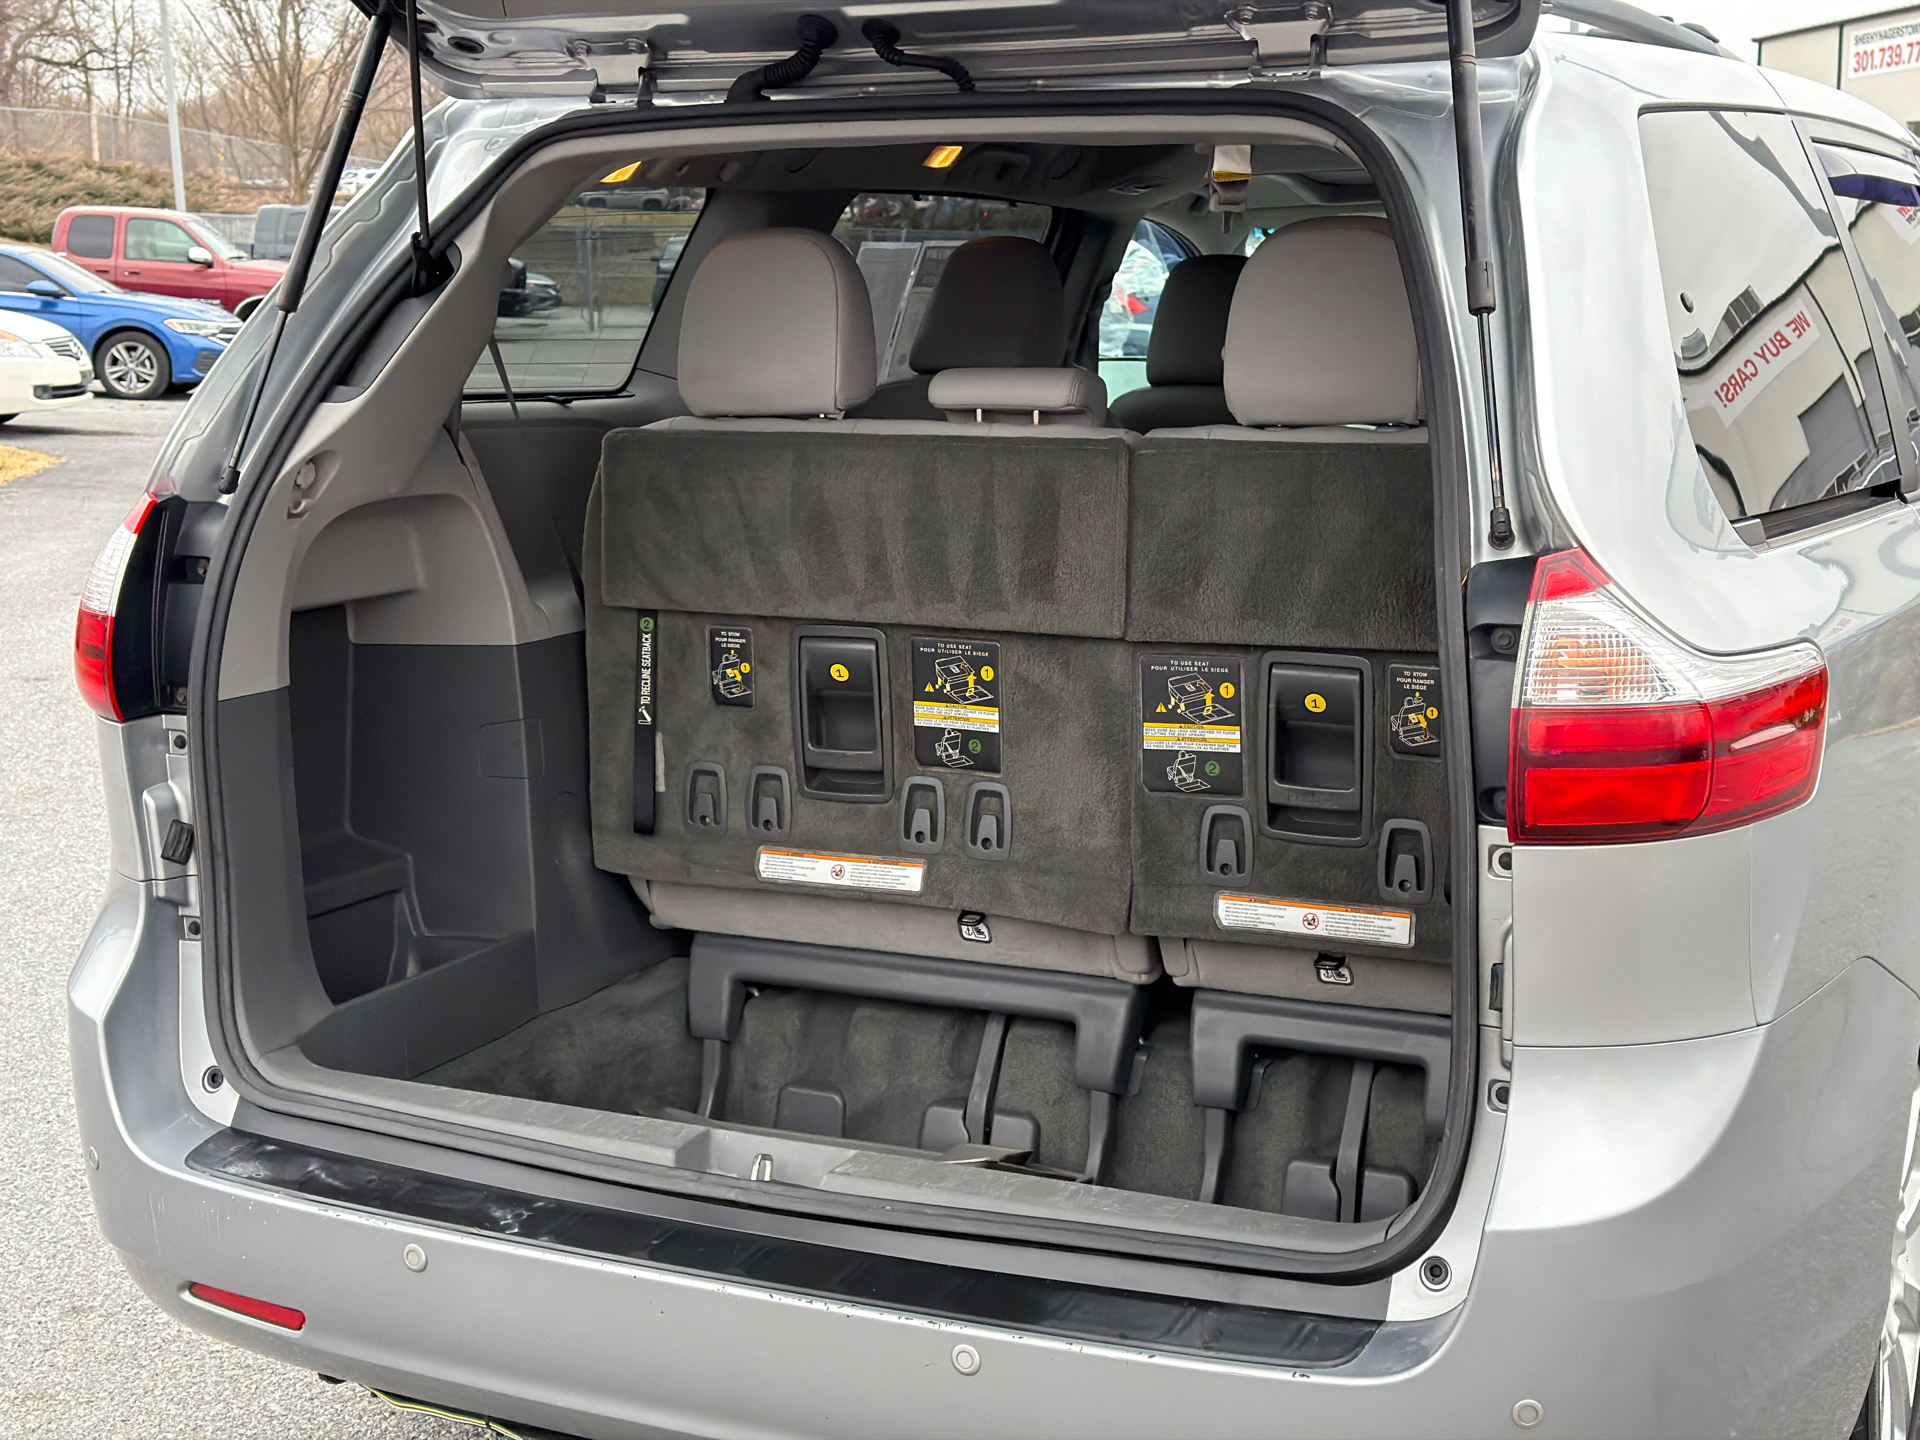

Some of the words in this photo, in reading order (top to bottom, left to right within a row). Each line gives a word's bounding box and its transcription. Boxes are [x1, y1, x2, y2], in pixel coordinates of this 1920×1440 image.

[641, 633, 652, 667] SEATBACK
[641, 668, 651, 695] RECLINE
[641, 696, 651, 704] TO
